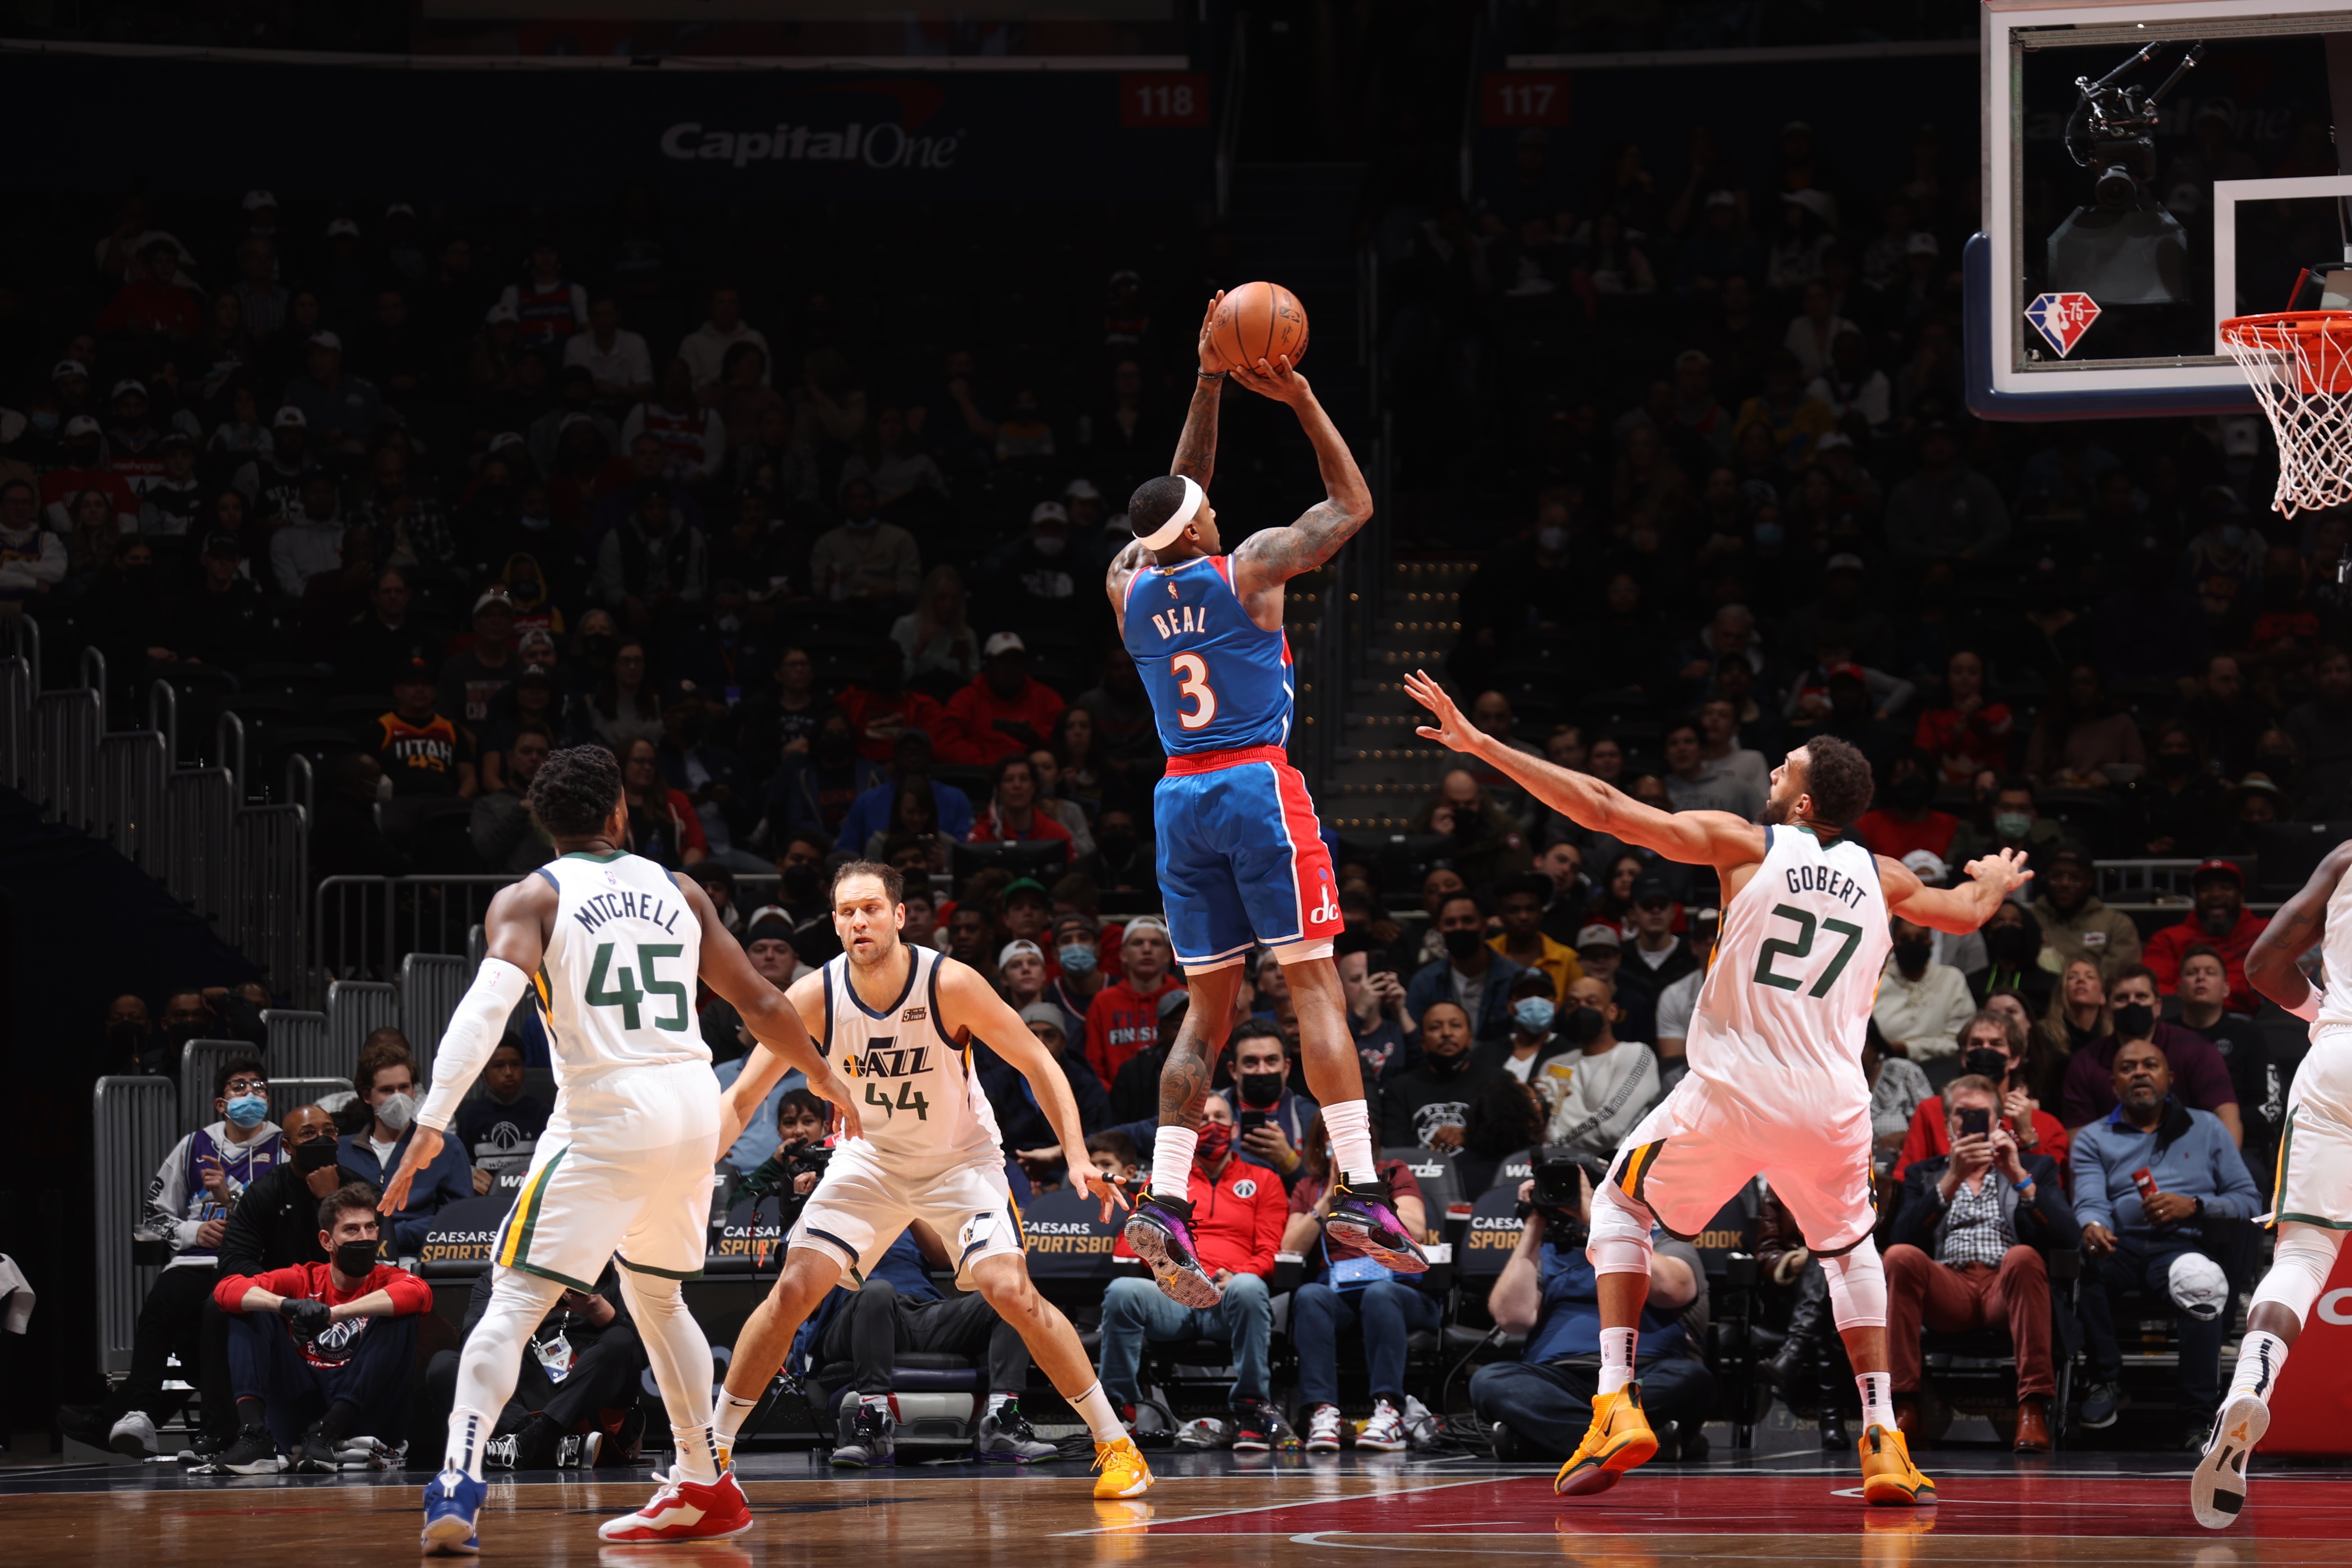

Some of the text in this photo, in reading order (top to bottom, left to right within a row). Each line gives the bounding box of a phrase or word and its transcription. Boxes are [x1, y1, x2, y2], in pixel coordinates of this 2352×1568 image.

[1136, 86, 1195, 117] 118
[1498, 86, 1557, 116] 117
[2069, 302, 2084, 321] 75
[1152, 605, 1206, 640] BEAL
[1170, 651, 1218, 731] 3
[395, 738, 453, 767] UTAH
[1786, 866, 1867, 909] GOBERT
[573, 891, 680, 935] MITCHELL
[1753, 903, 1863, 999] 27
[584, 942, 689, 1032] 45
[903, 1010, 911, 1021] 5
[844, 1035, 934, 1078] JAZZ
[865, 1081, 930, 1121] 44
[426, 1231, 497, 1243] CAESARS
[1021, 1220, 1090, 1235] CAESARS
